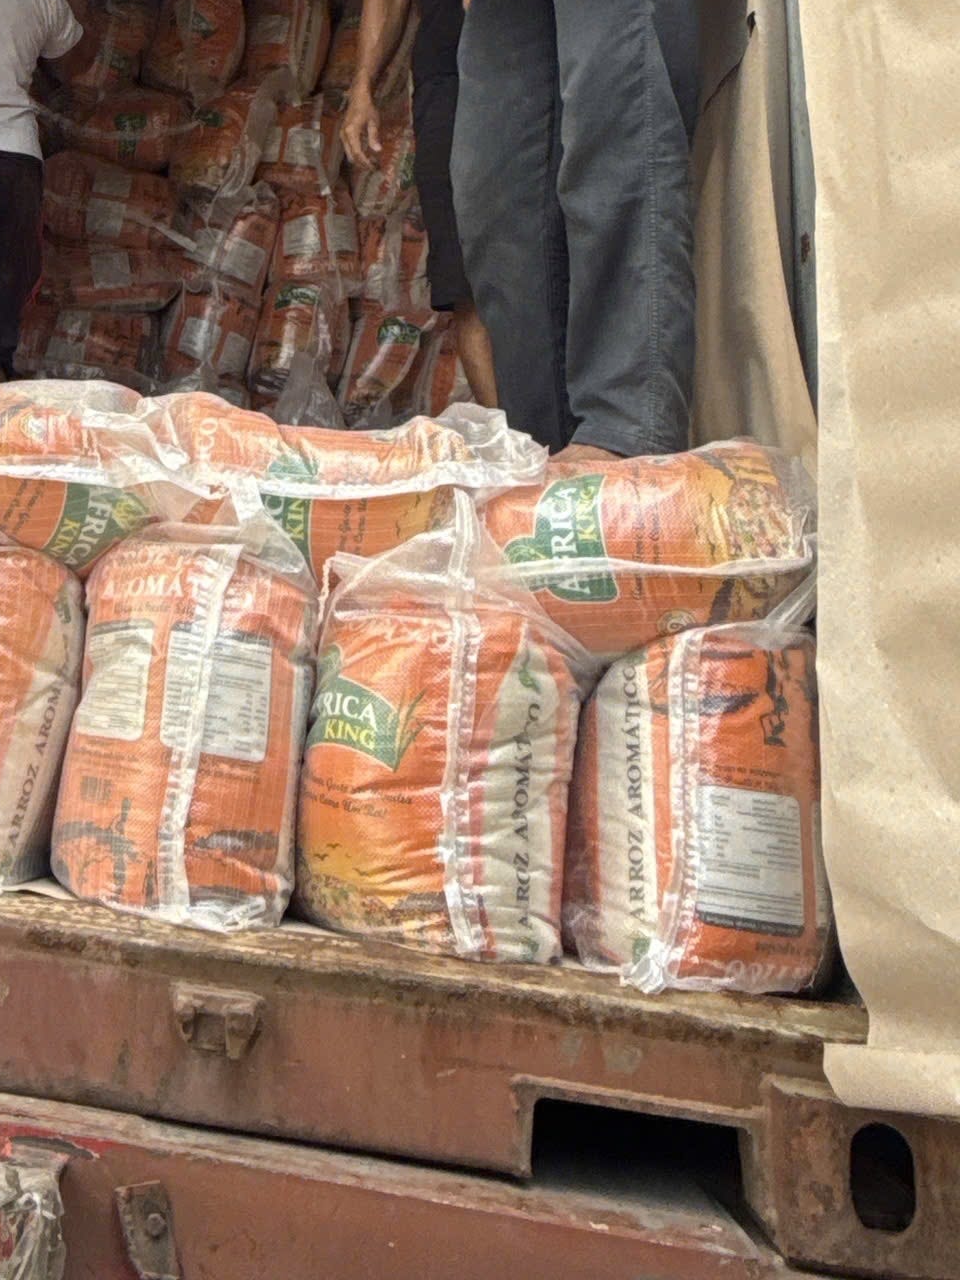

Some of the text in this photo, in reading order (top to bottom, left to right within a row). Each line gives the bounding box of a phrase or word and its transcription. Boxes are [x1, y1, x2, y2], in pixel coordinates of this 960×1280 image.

[287, 499, 305, 540] KIN
[324, 718, 376, 751] KING
[7, 763, 40, 849] ARROZ
[512, 851, 534, 929] AROZ
[628, 829, 645, 922] ARROZ
